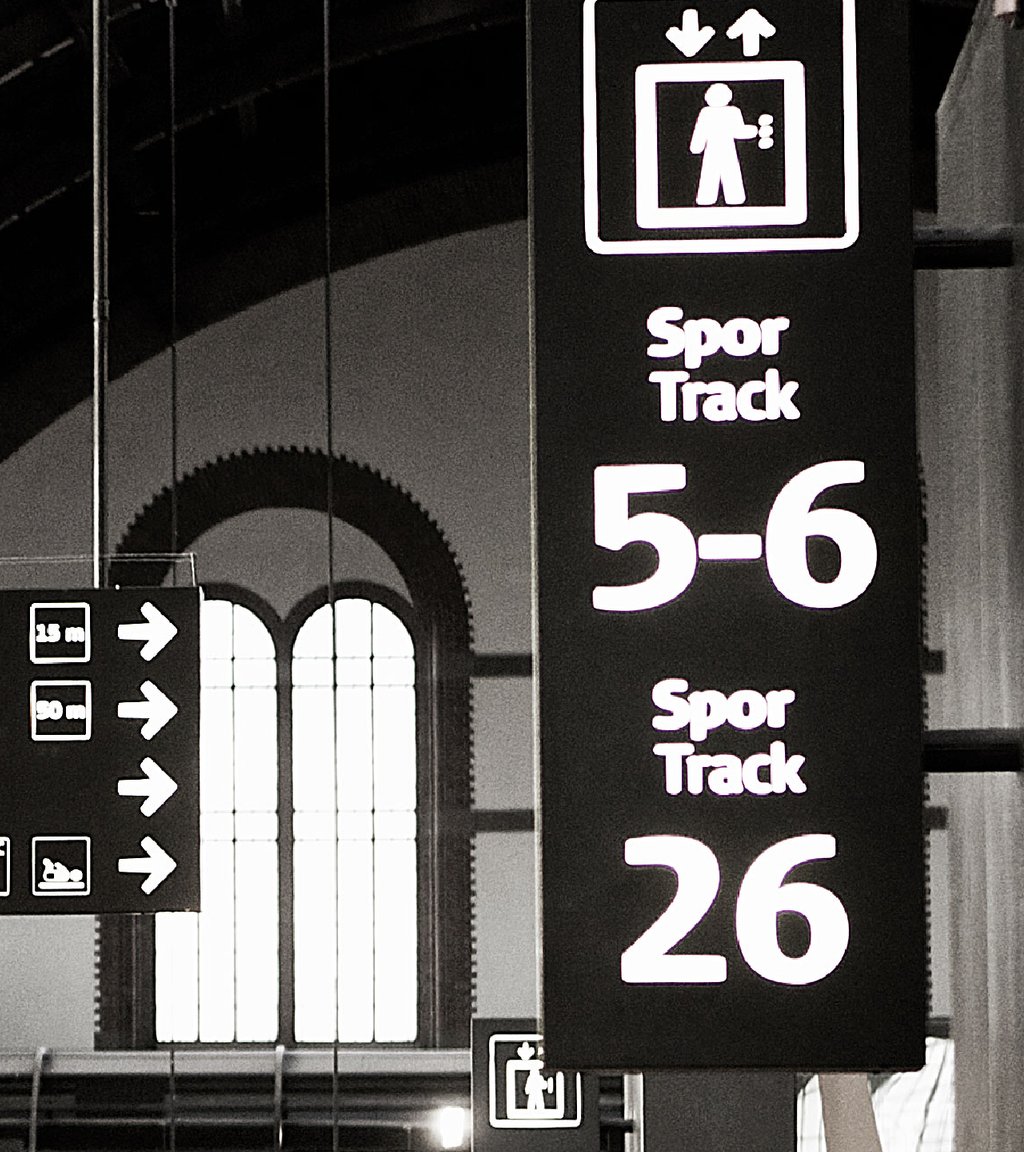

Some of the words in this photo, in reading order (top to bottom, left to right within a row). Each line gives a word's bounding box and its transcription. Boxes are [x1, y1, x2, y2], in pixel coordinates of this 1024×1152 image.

[647, 307, 790, 370] Spor
[648, 367, 801, 422] Track
[592, 460, 878, 612] 5-6
[35, 623, 61, 643] 15
[64, 626, 86, 643] m
[651, 677, 796, 742] Spor
[652, 740, 808, 796] Track
[620, 833, 850, 985] 26
